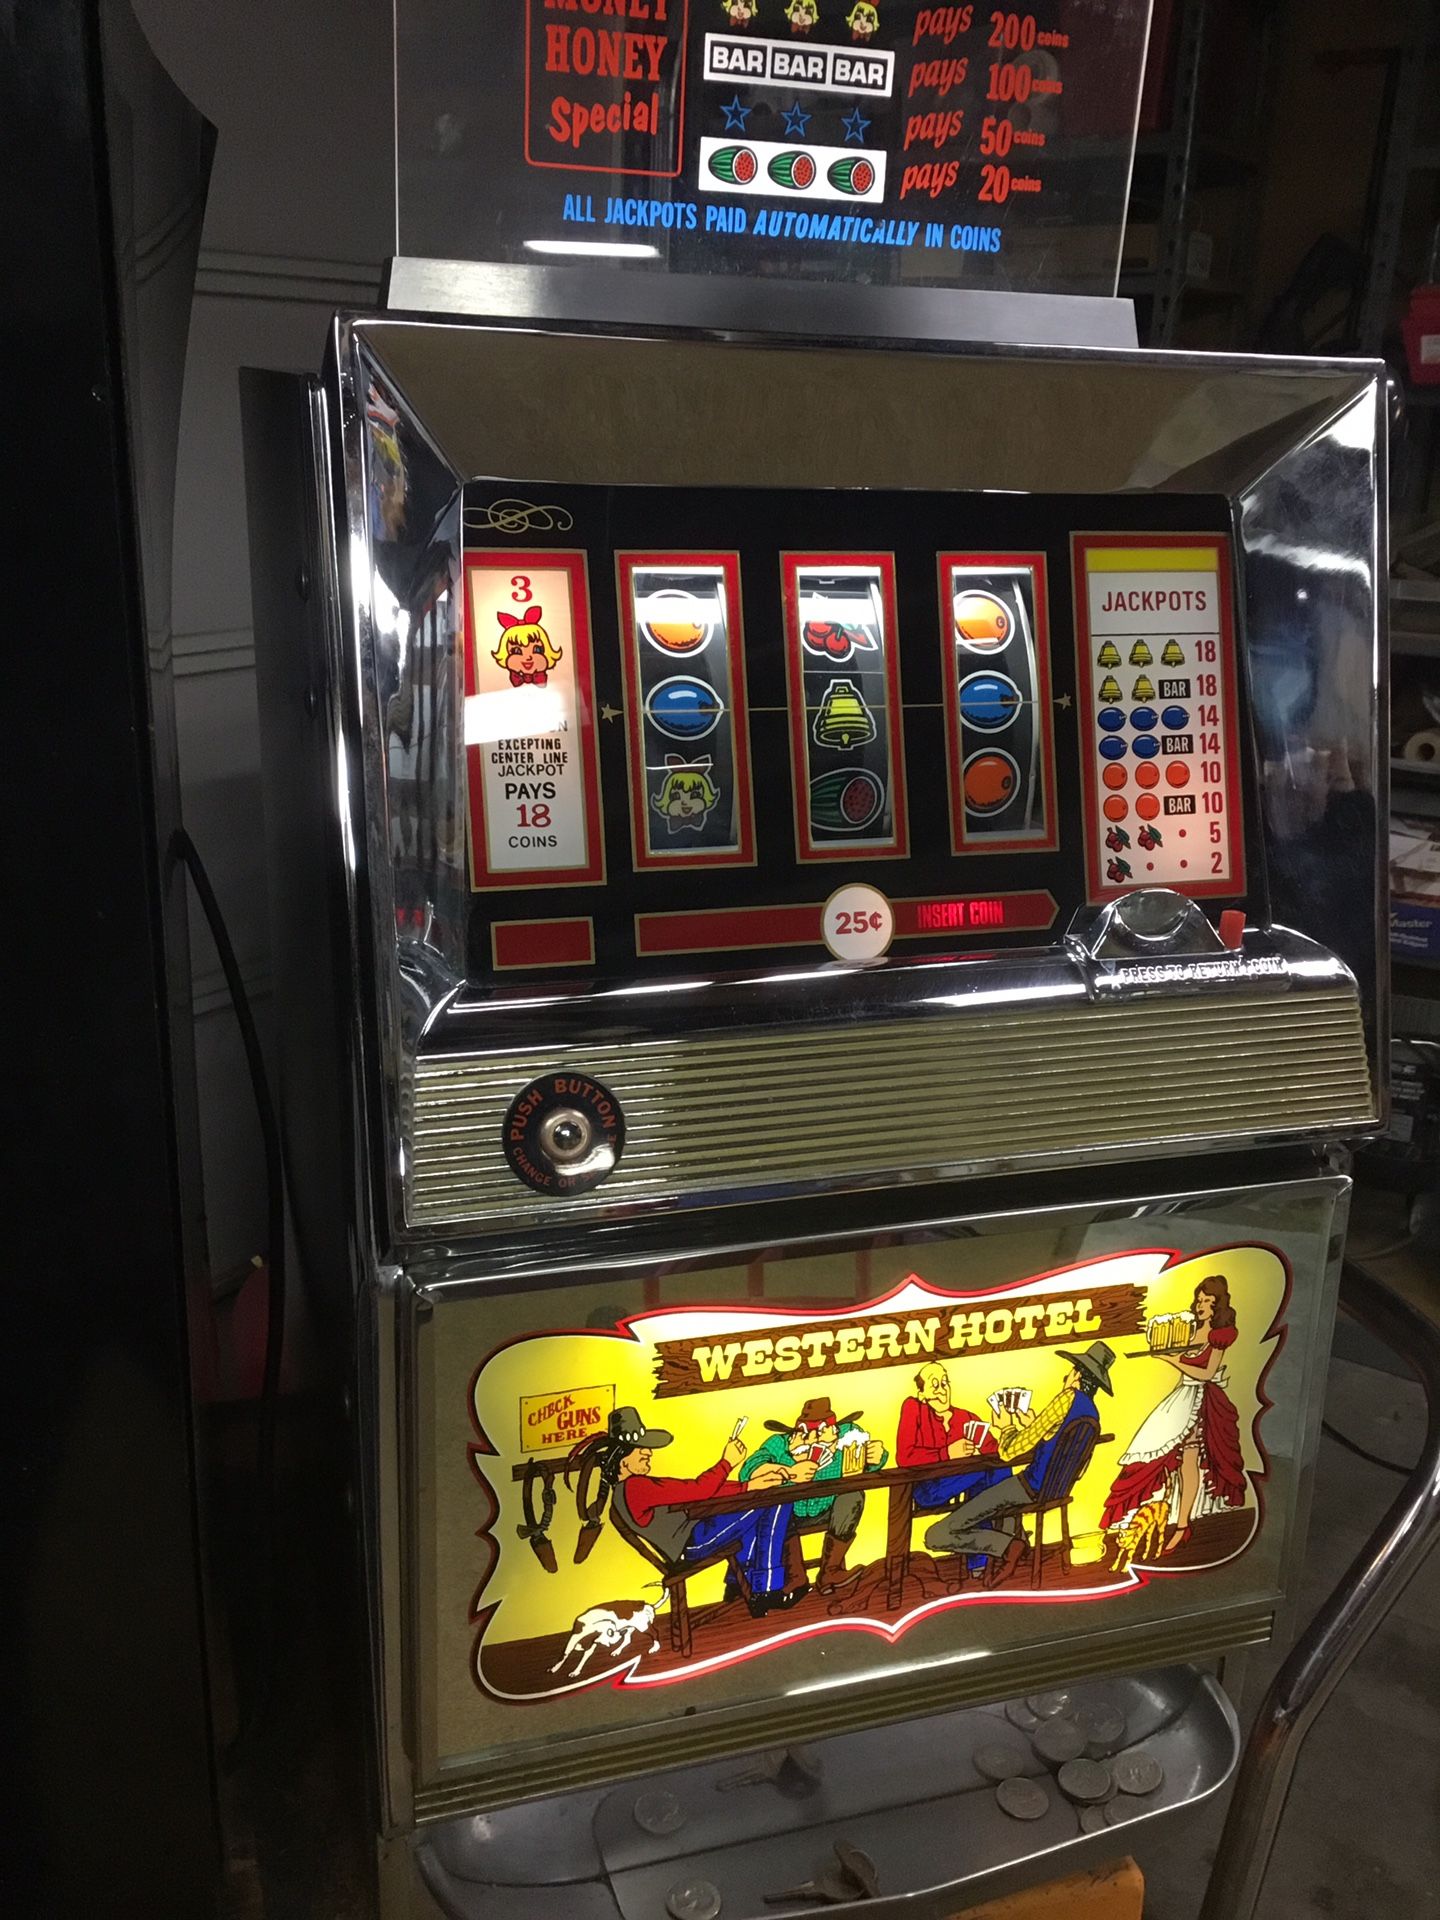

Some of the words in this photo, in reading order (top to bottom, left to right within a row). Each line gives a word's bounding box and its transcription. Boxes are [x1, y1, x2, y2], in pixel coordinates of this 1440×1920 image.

[912, 4, 974, 47] pays
[987, 10, 1036, 51] 200
[1037, 31, 1070, 48] coins
[545, 24, 668, 81] HONEY
[712, 46, 764, 73] BAR
[773, 52, 824, 79] BAR
[834, 59, 884, 86] BAR
[908, 57, 969, 98] pays
[986, 63, 1032, 103] 100
[1032, 79, 1063, 94] coins
[549, 91, 659, 148] Special
[903, 110, 964, 151] pays
[979, 117, 1013, 157] 50
[1013, 130, 1046, 147] coins
[900, 161, 960, 200] pays
[978, 164, 1010, 204] 20
[1011, 176, 1042, 192] coins
[563, 193, 596, 223] ALL
[604, 197, 697, 230] JACKPOTS
[705, 205, 747, 234] PAID
[752, 209, 920, 246] AUTOMATICALLY
[924, 222, 945, 248] IN
[950, 224, 1002, 253] COINS
[510, 575, 533, 602] 3
[1102, 590, 1207, 612] JACKPOTS
[1194, 639, 1217, 663] 18
[1162, 682, 1187, 698] BAR
[1196, 674, 1218, 697] 18
[1198, 704, 1220, 727] 14
[497, 738, 562, 751] EXCEPTING
[1165, 736, 1189, 753] BAR
[1199, 733, 1221, 755] 14
[491, 752, 535, 765] CENTER
[543, 752, 568, 764] LINE
[498, 764, 565, 777] JACKPOT
[1200, 761, 1222, 783] 10
[504, 781, 556, 800] PAYS
[1168, 798, 1192, 814] BAR
[1202, 791, 1224, 814] 10
[516, 803, 552, 828] 18
[508, 835, 557, 848] COINS
[1209, 821, 1221, 844] 5
[1210, 851, 1223, 874] 2
[835, 911, 883, 935] 25¢
[917, 902, 964, 929] INSERT
[969, 901, 1004, 925] COIN
[1120, 965, 1166, 984] PRESS
[1188, 960, 1240, 979] RETURN
[510, 1088, 544, 1143] PUSH
[554, 1078, 617, 1129] BUTTON
[512, 1147, 551, 1186] CHANGE
[558, 1177, 576, 1188] OR
[692, 1317, 943, 1383] WESTERN
[948, 1299, 1102, 1350] HOTEL
[557, 1406, 601, 1430] GUNS
[542, 1428, 587, 1444] HERE
